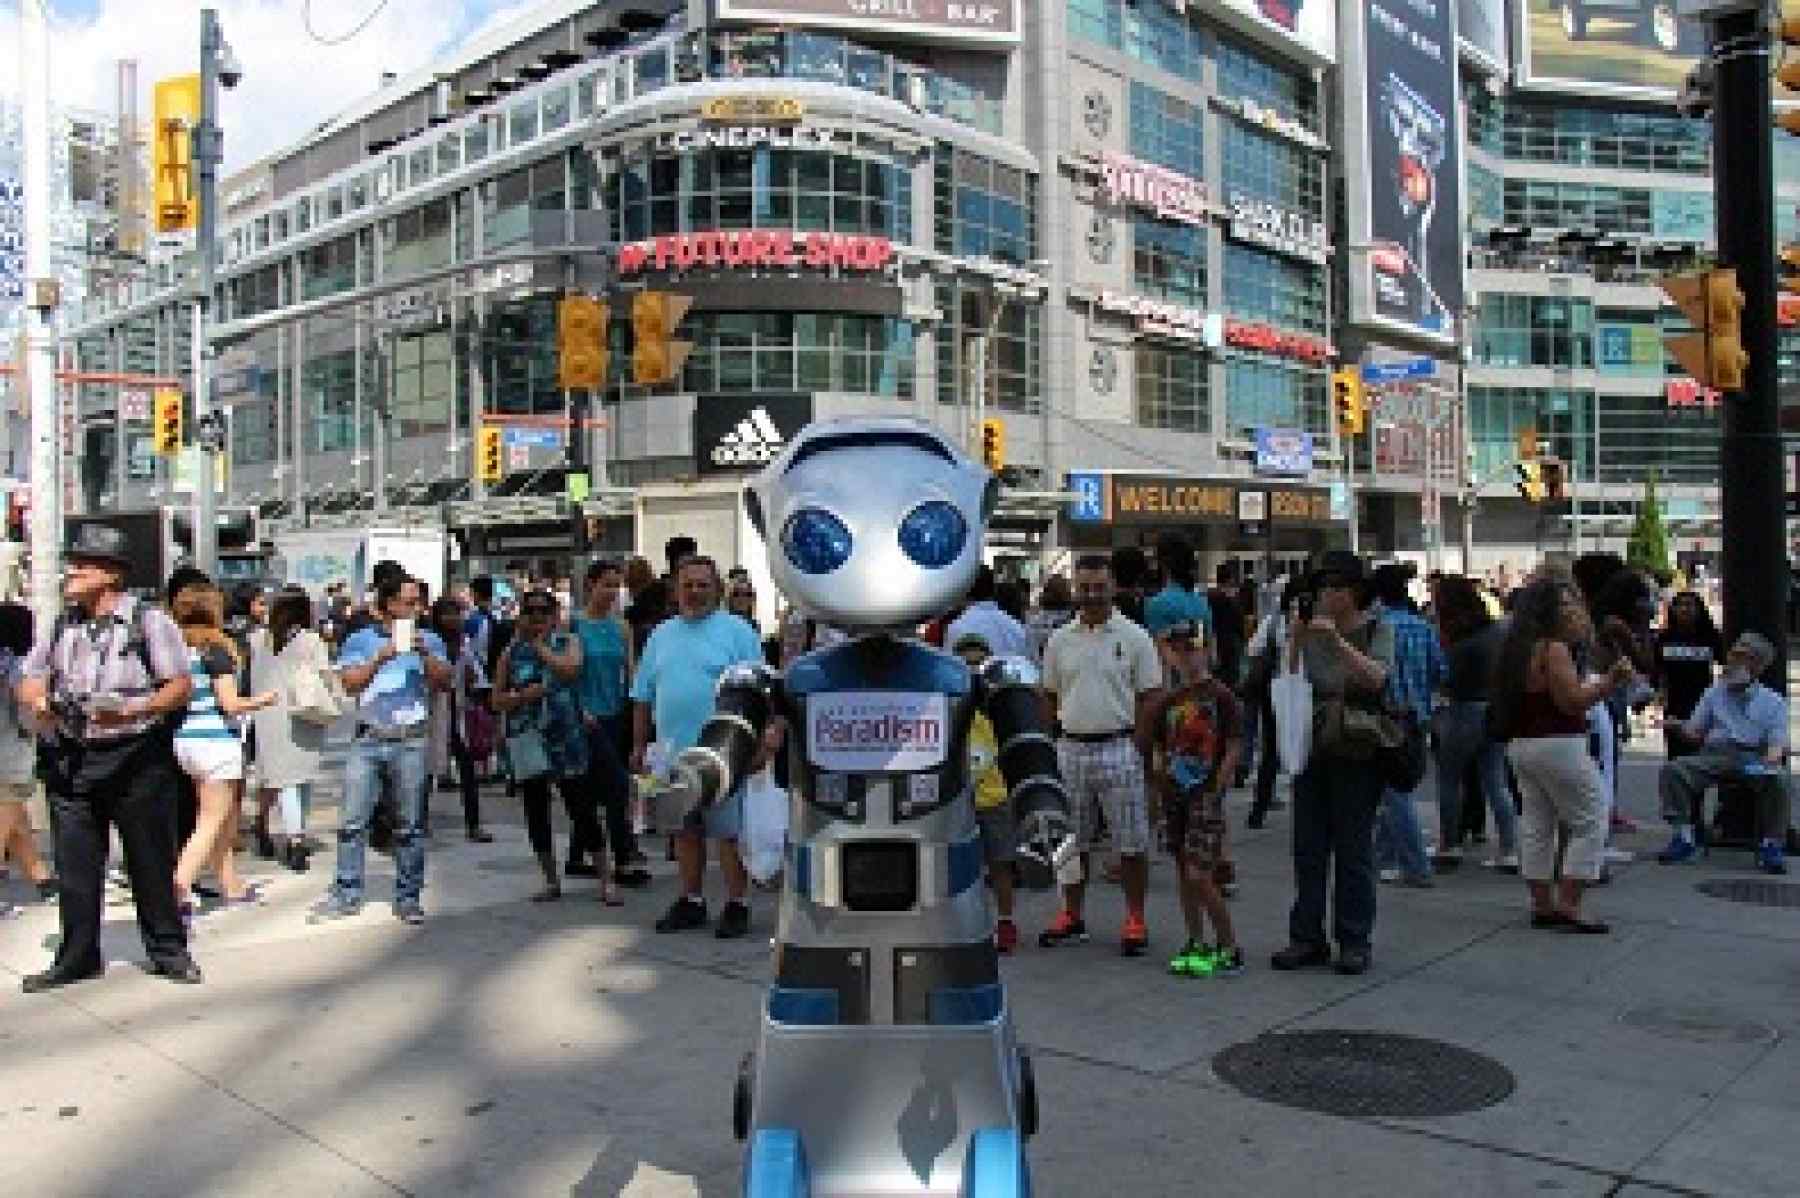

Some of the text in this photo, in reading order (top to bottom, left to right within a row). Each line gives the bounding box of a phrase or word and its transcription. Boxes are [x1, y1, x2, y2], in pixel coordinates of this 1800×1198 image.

[947, 4, 998, 24] BAR
[674, 127, 834, 149] CINEPLEX
[654, 230, 893, 270] FUTURE SHOP
[710, 443, 782, 464] adid
[1117, 484, 1235, 516] WELCOME
